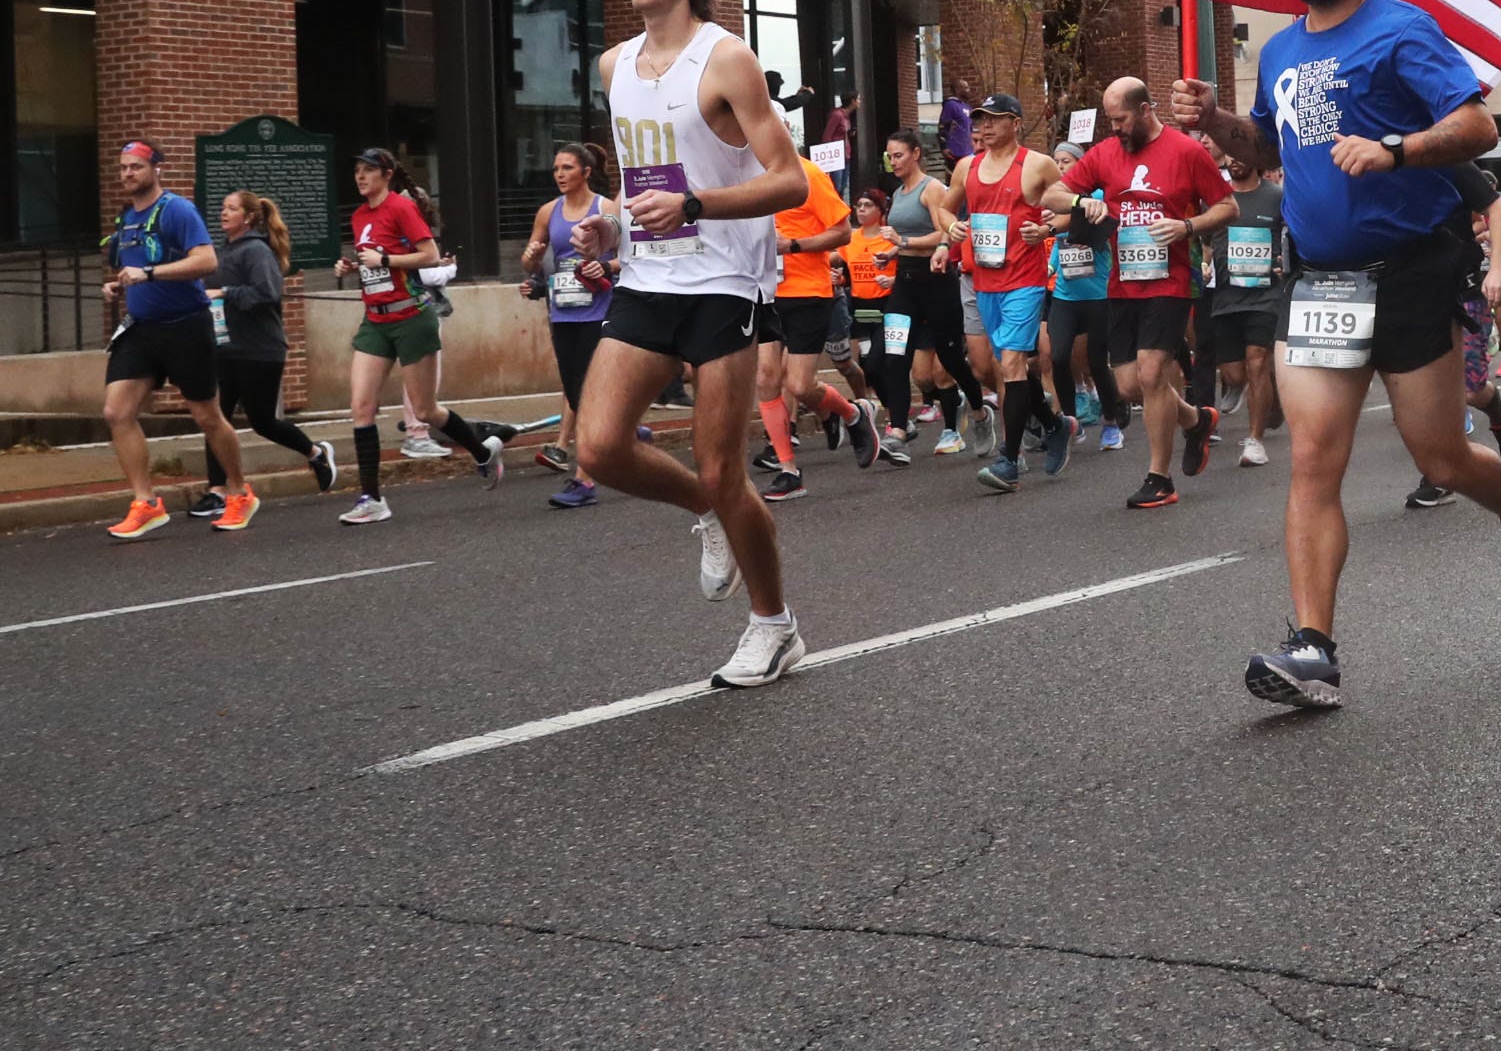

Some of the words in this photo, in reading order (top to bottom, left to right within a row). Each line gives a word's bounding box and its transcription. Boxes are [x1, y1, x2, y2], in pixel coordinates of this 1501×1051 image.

[1301, 62, 1312, 71] WE
[1298, 72, 1334, 90] STRONG
[1298, 88, 1310, 98] WE
[1324, 80, 1348, 91] UNTIL
[1298, 92, 1326, 108] BEING
[1298, 101, 1336, 119] STRONG
[1300, 119, 1306, 128] IS
[1307, 116, 1320, 126] THE
[1321, 111, 1343, 123] ONLY
[1300, 120, 1340, 138] CHOICE
[615, 116, 677, 168] 901
[1301, 137, 1315, 147] WE
[1120, 201, 1134, 212] St.
[1136, 200, 1164, 210] Jude
[1120, 210, 1164, 226] HERO
[973, 234, 1000, 246] 7852
[1060, 252, 1092, 262] 30268
[1119, 248, 1166, 262] 33695
[1230, 246, 1271, 258] 10927
[854, 264, 874, 272] PACE
[556, 276, 584, 287] 124
[1303, 310, 1356, 334] 1139
[1308, 338, 1348, 346] MARATHON
